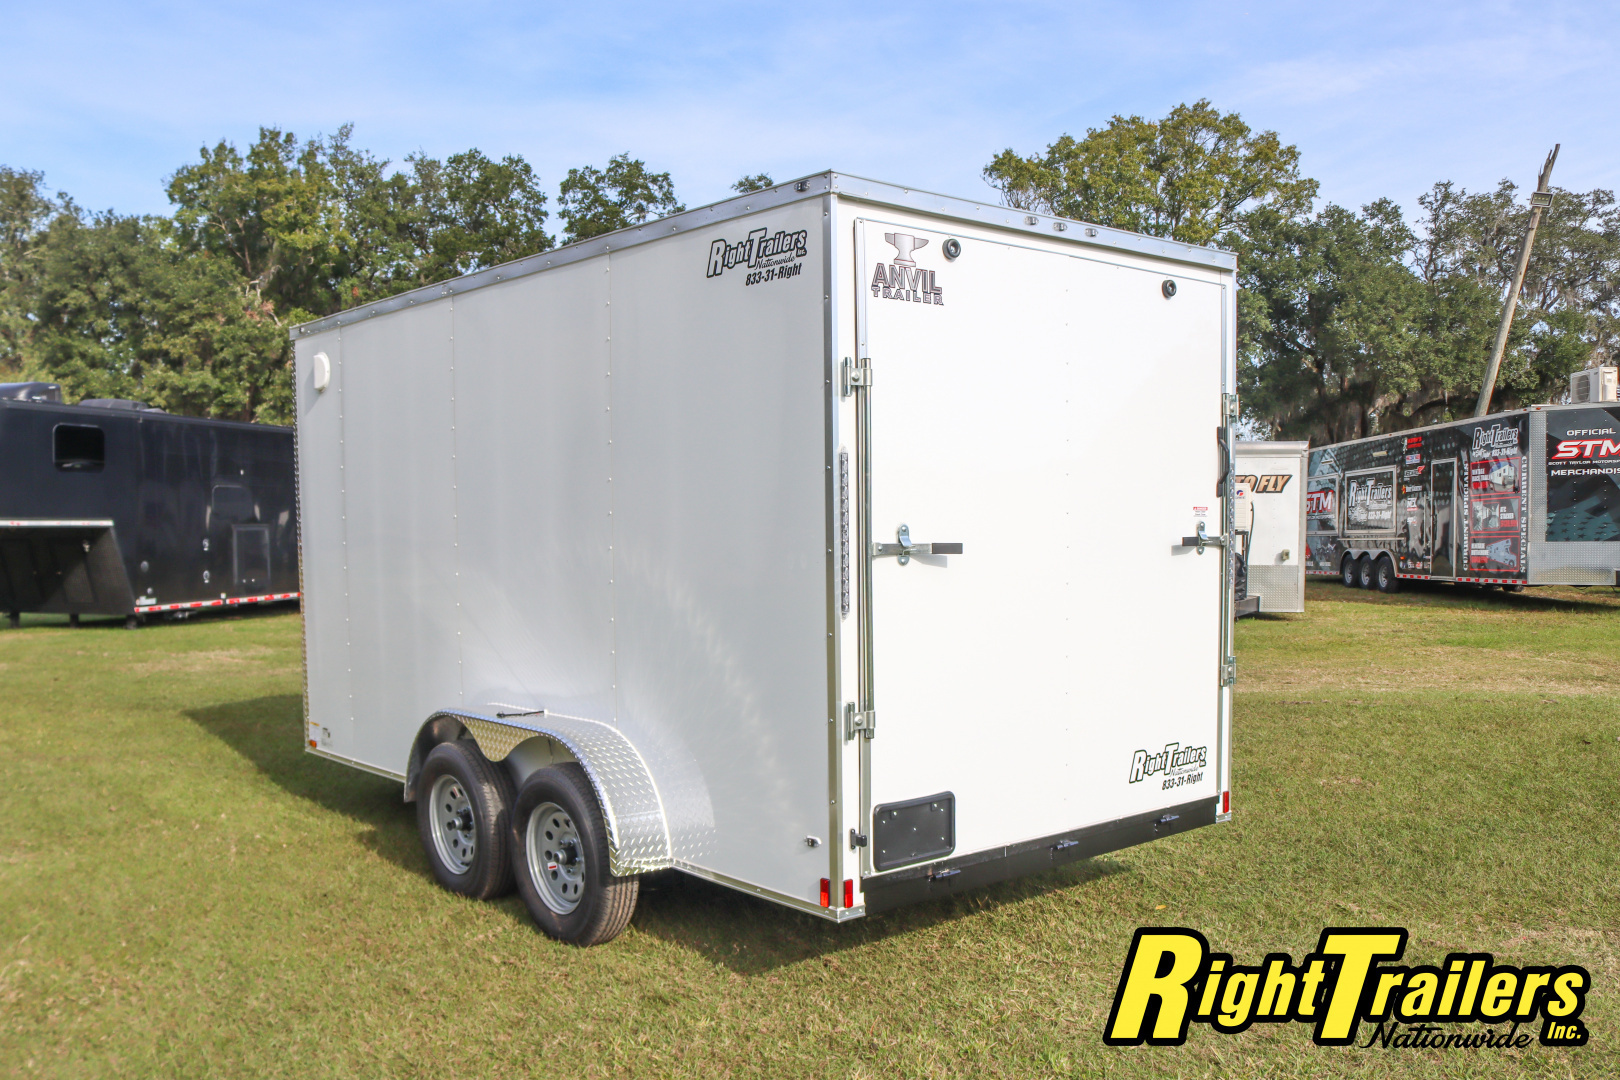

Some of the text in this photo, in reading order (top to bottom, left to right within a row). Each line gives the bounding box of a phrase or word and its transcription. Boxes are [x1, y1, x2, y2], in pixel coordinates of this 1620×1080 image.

[754, 252, 796, 270] Nationwide
[745, 262, 802, 286] 833-31-Right
[872, 263, 943, 294] ANVIL
[871, 285, 944, 306] TRAILER
[1566, 428, 1617, 436] OFFICIAL
[1551, 439, 1620, 459] STM
[1255, 474, 1293, 493] FLY
[1162, 771, 1203, 790] 833-31-Right
